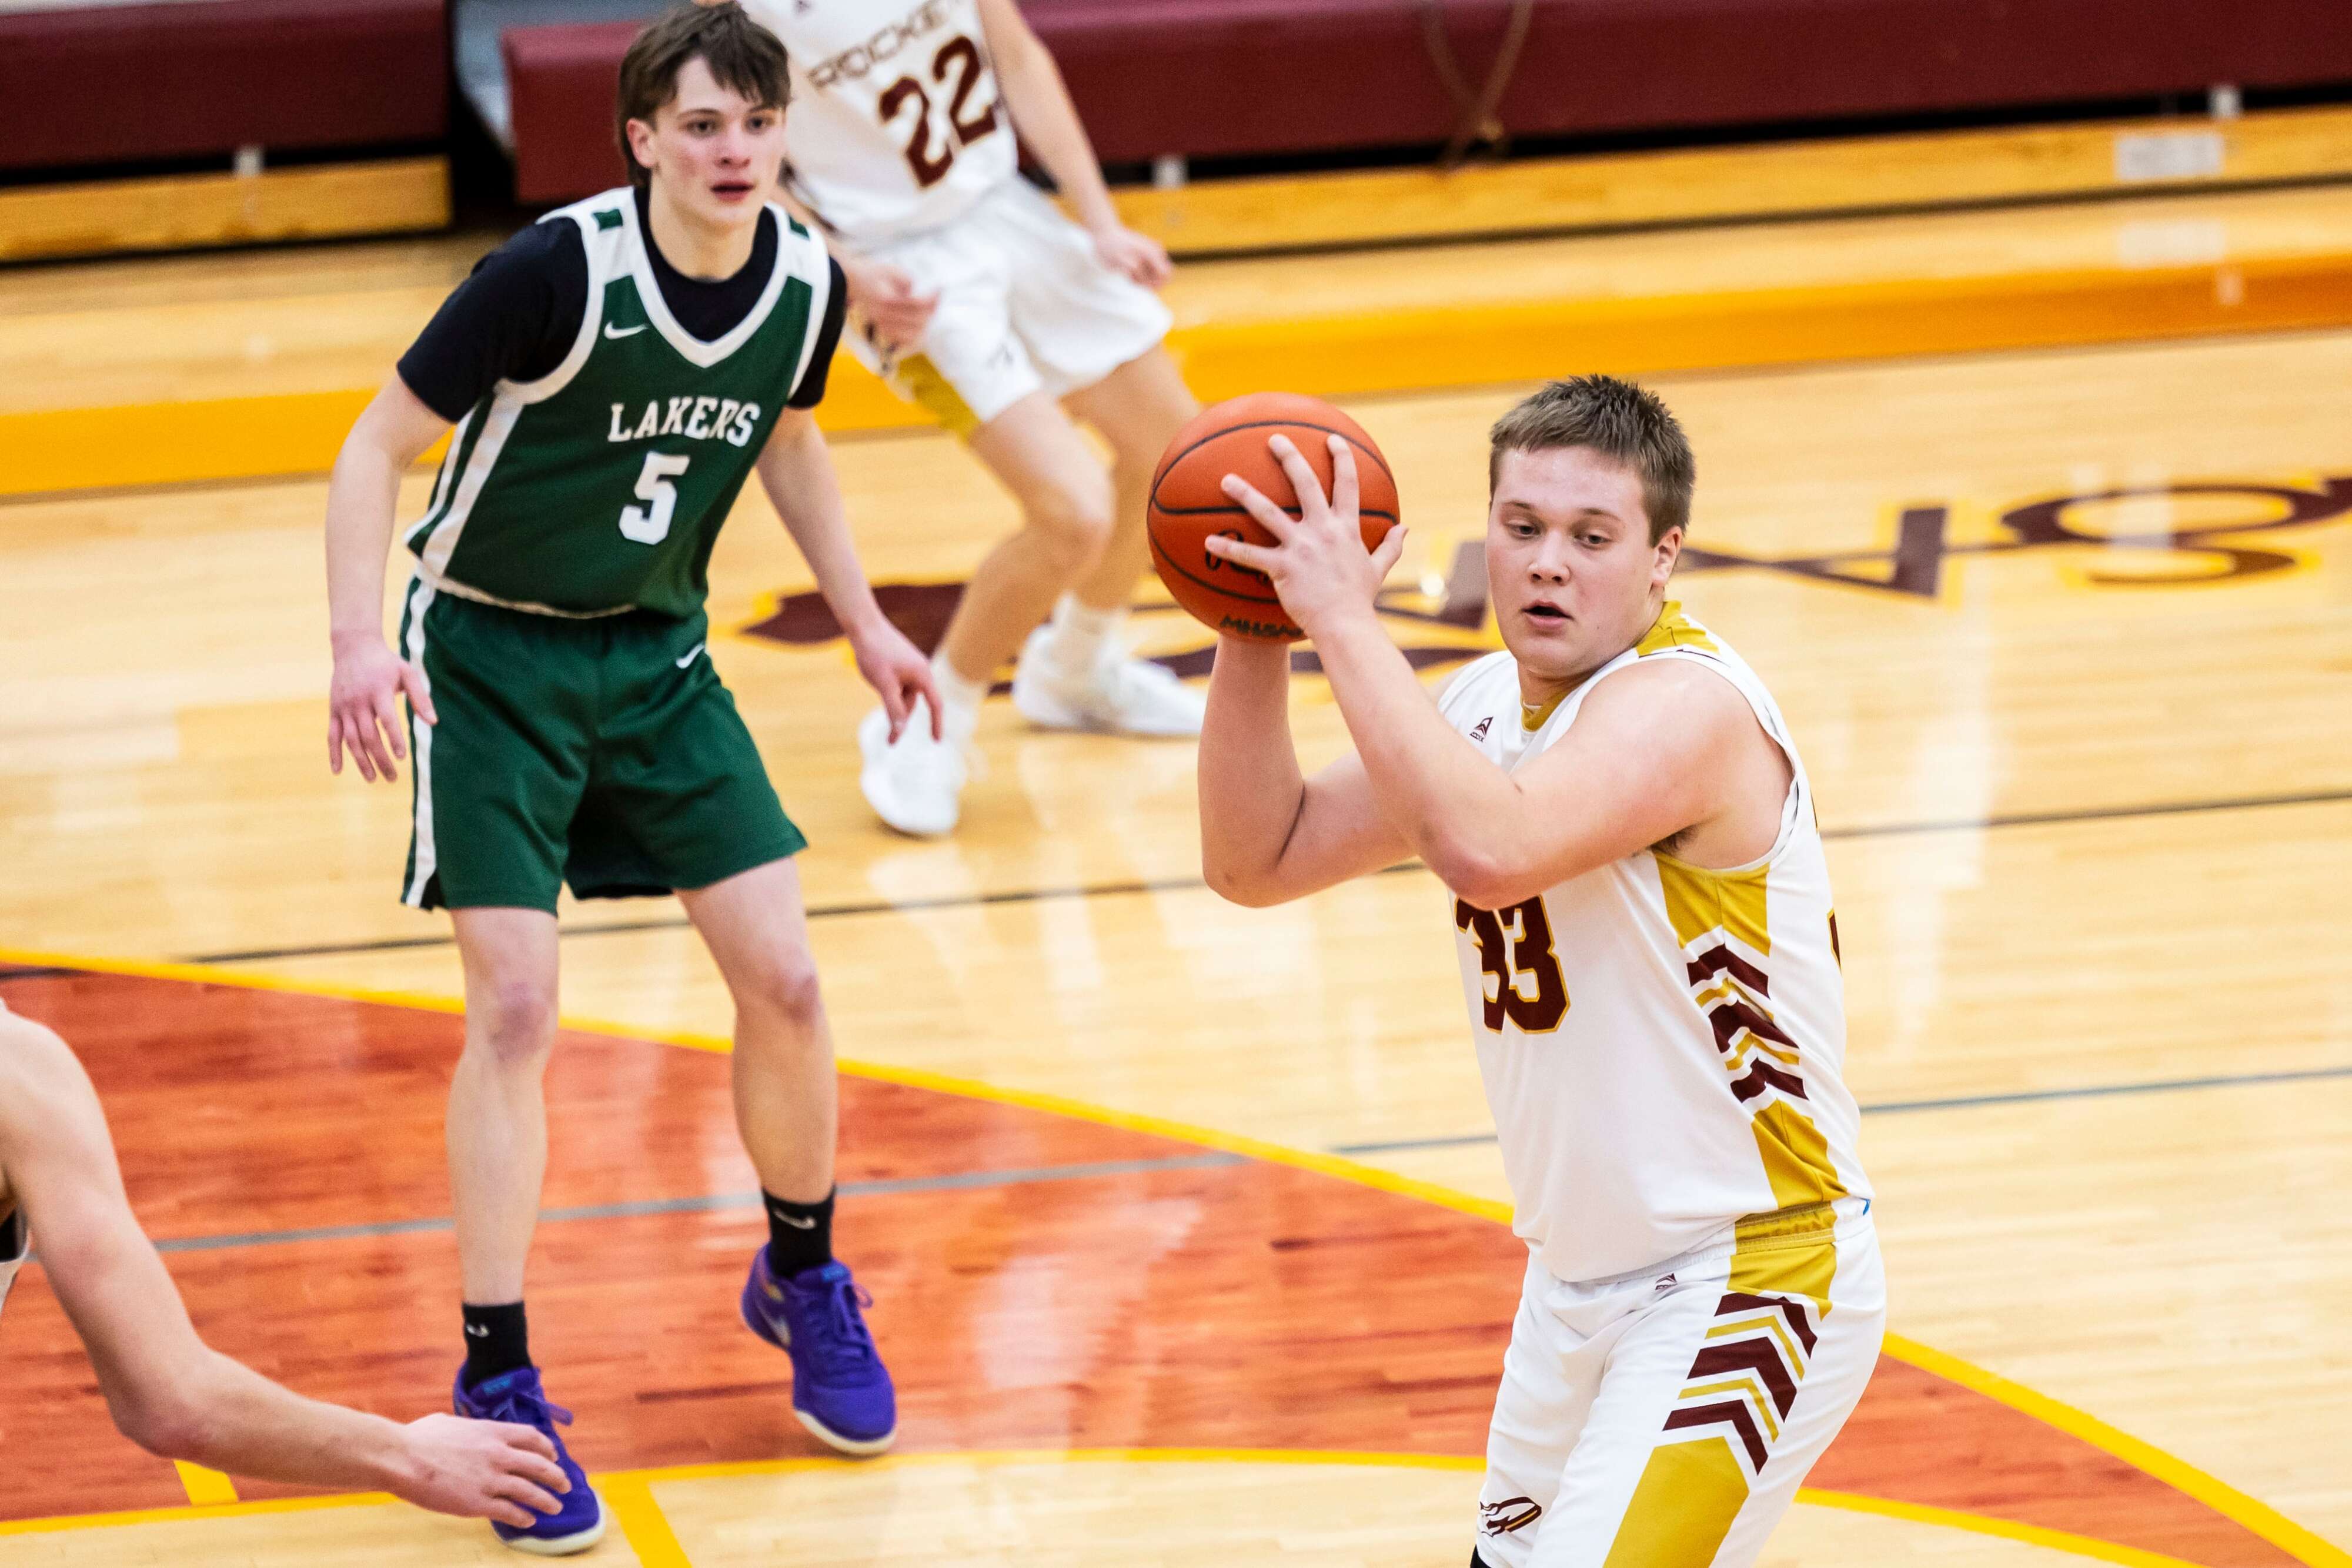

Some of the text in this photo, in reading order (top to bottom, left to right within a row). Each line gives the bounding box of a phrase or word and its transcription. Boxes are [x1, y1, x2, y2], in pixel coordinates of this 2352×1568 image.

[878, 35, 997, 188] 22
[607, 395, 761, 447] LAKERS
[619, 450, 691, 546] 5
[1454, 894, 1571, 1035] 33
